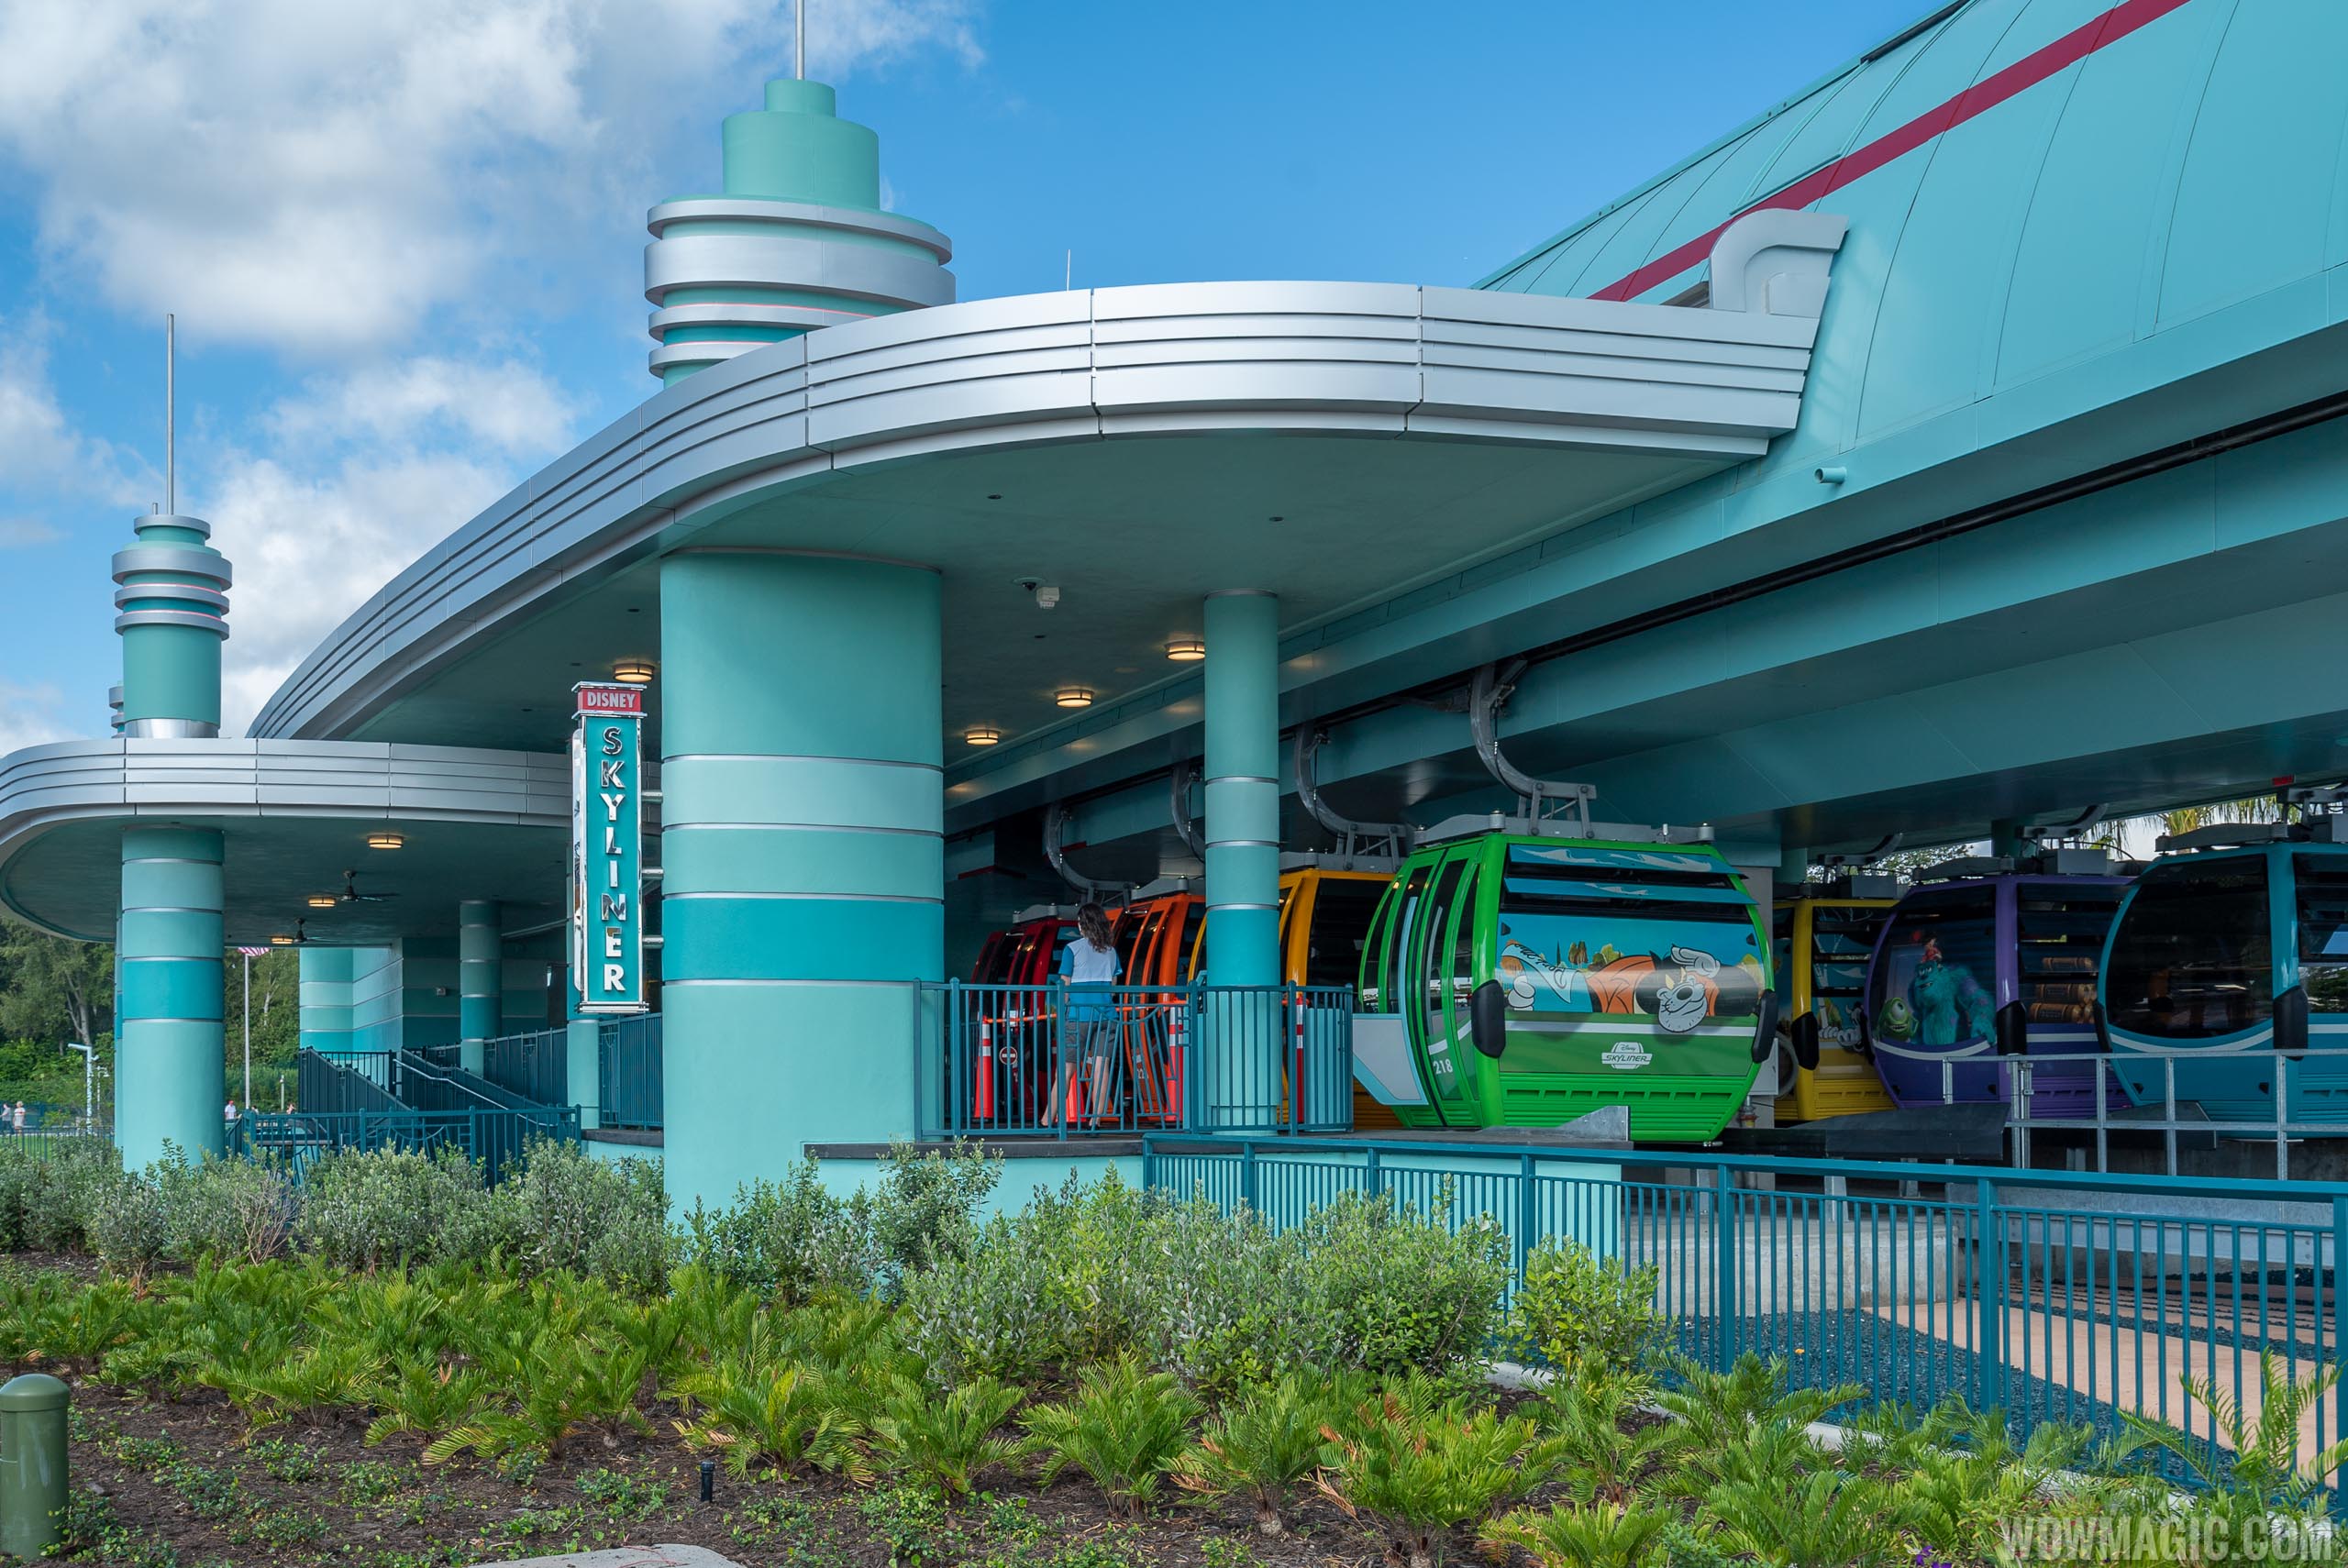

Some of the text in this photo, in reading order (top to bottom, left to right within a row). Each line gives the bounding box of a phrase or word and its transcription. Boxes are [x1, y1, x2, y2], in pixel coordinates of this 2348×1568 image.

[587, 691, 636, 708] DISNEY
[600, 727, 626, 991] SKYLINER
[1433, 1058, 1454, 1075] 218
[1605, 1055, 1648, 1063] SKYLINER
